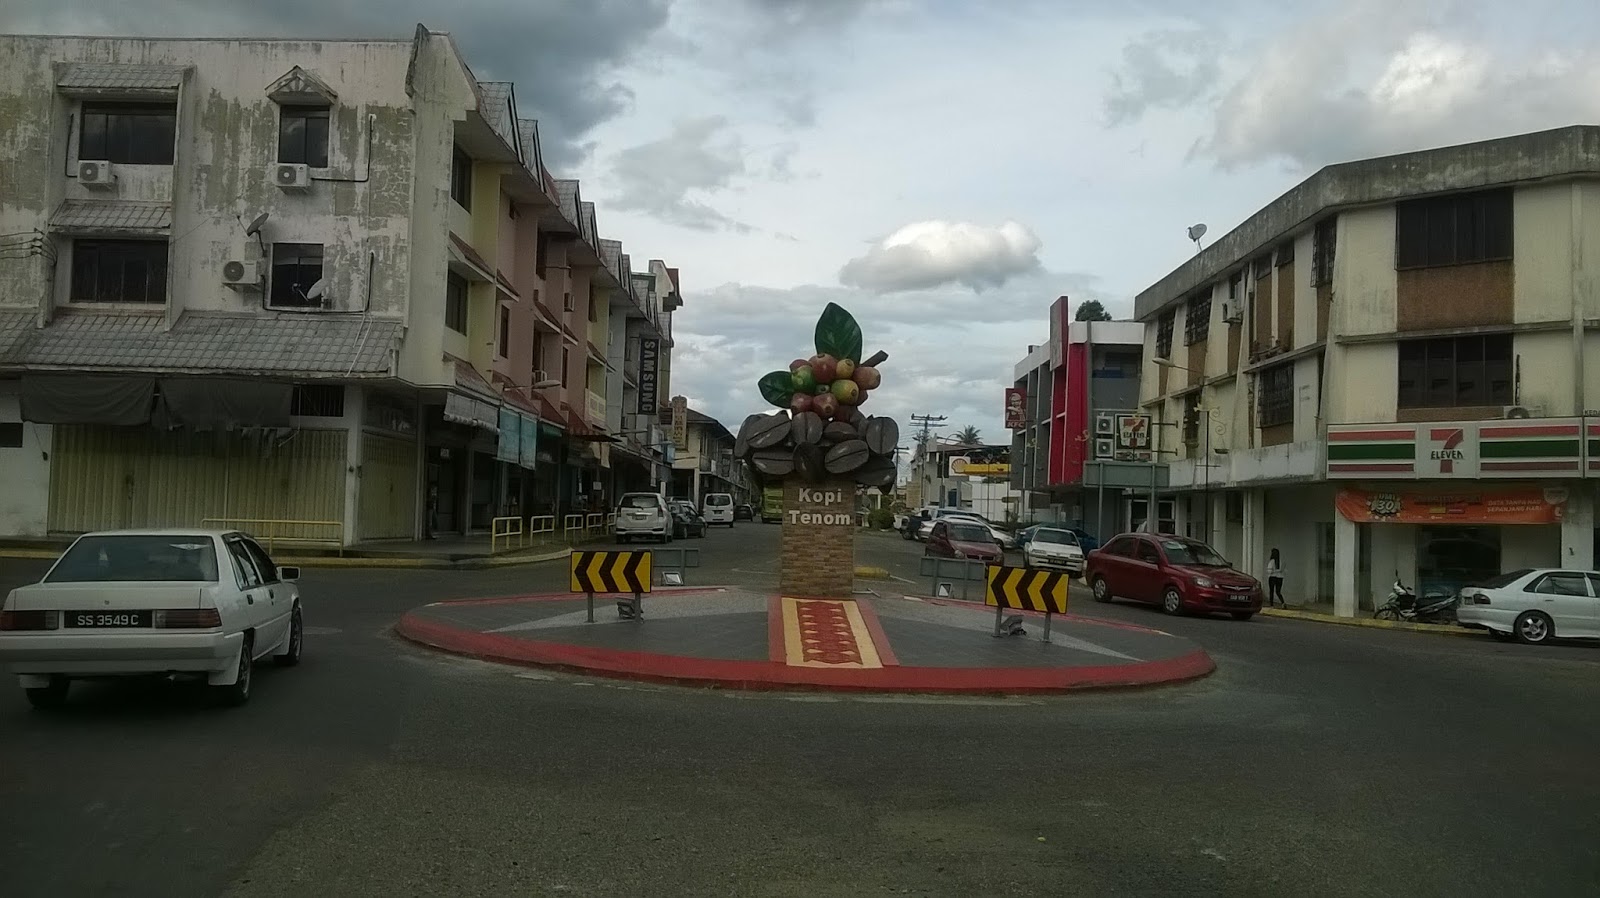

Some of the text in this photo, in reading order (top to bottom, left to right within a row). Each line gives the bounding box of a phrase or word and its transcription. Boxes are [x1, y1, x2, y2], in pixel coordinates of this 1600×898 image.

[641, 340, 656, 412] SAMSUNG
[1430, 428, 1463, 473] 7
[798, 487, 842, 506] Kopi
[1376, 500, 1394, 510] 30
[788, 509, 851, 525] Tenom
[77, 614, 139, 626] SS 3549 C
